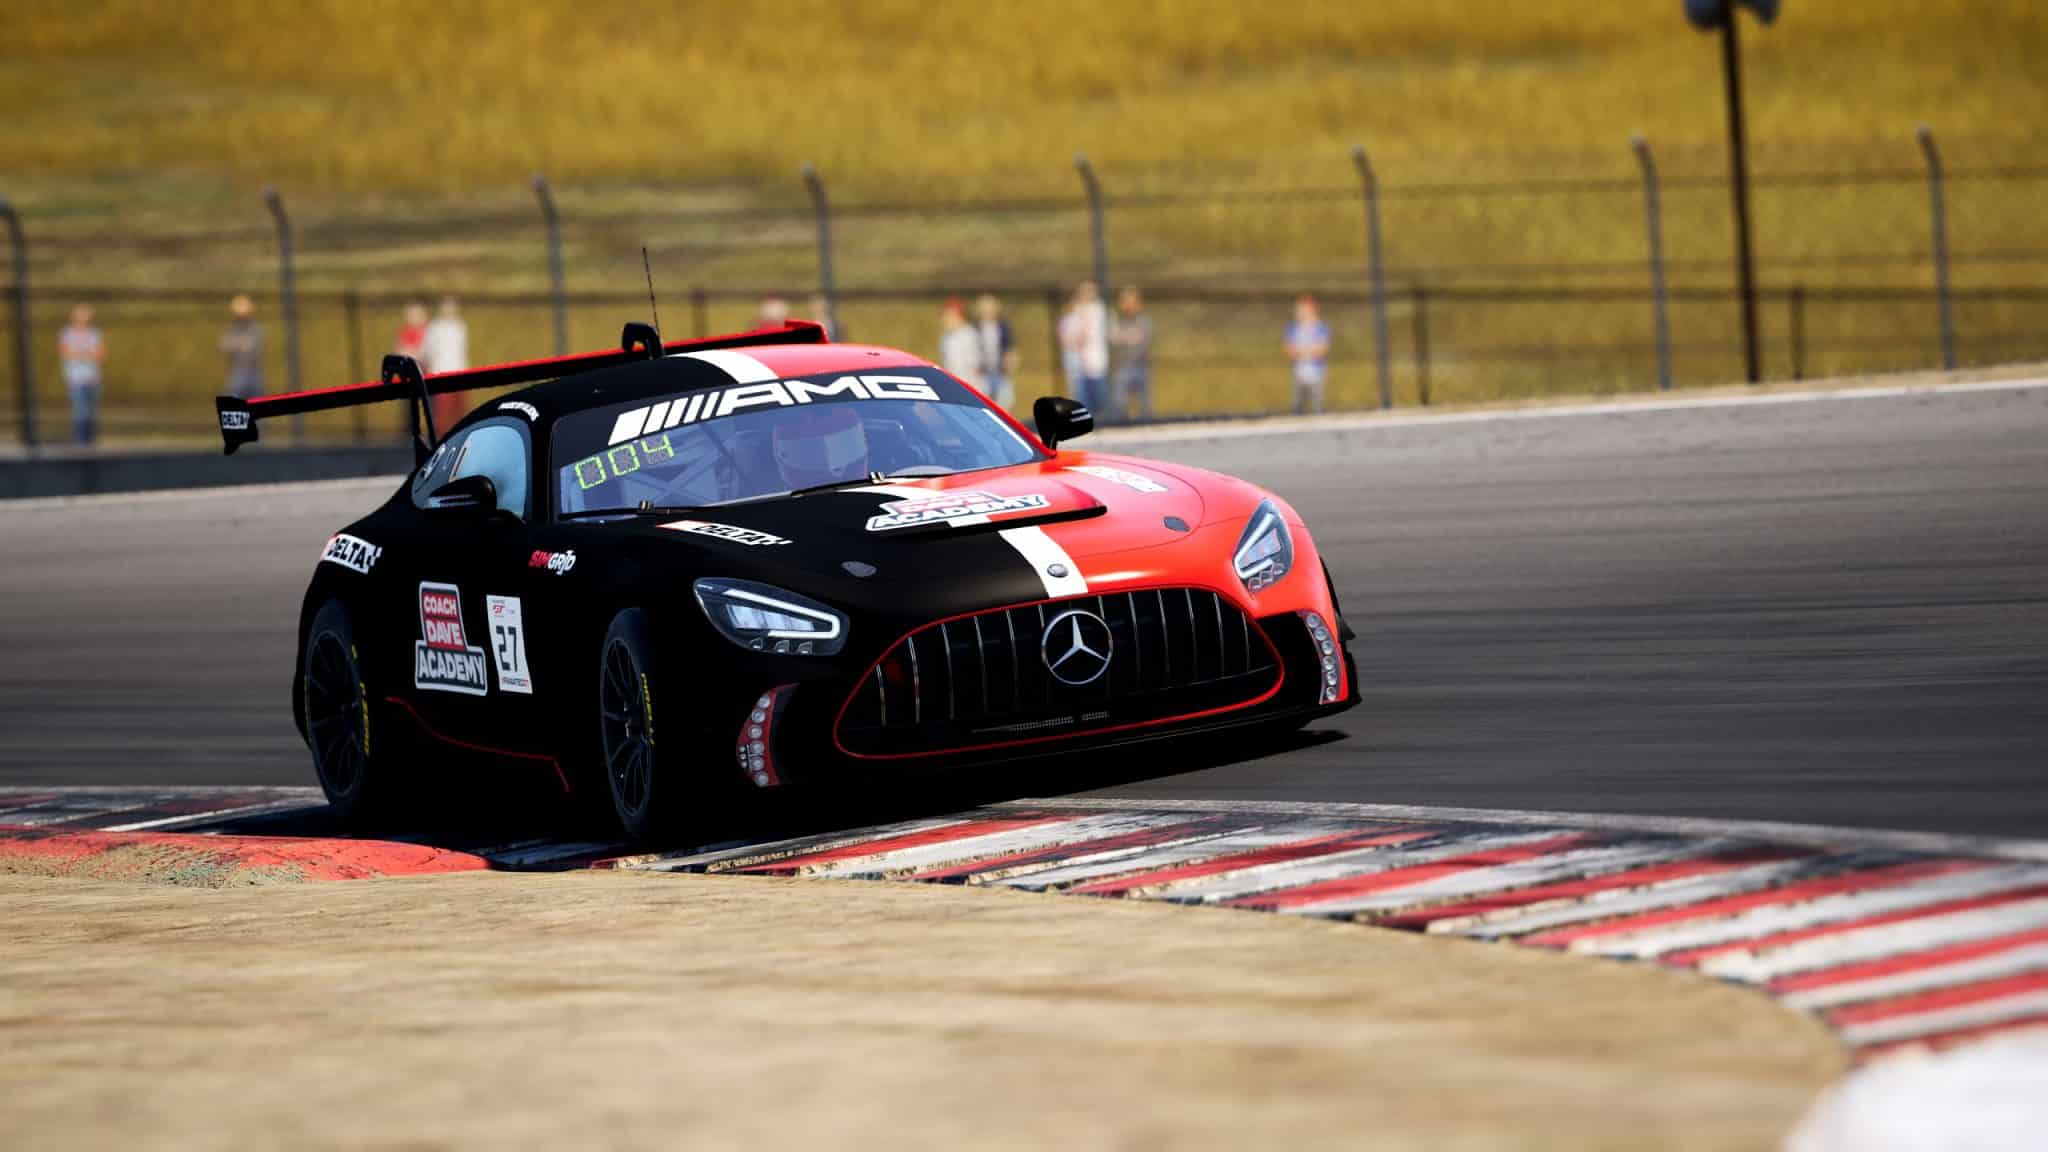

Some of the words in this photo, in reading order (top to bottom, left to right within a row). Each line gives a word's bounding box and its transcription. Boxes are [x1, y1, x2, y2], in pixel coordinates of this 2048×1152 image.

[716, 376, 940, 416] AMG
[575, 434, 674, 489] 004
[875, 495, 1041, 527] ACADEMY
[424, 596, 457, 616] COACH
[426, 620, 463, 645] DAVE
[496, 625, 518, 672] 27
[420, 649, 485, 687] ACADEMY
